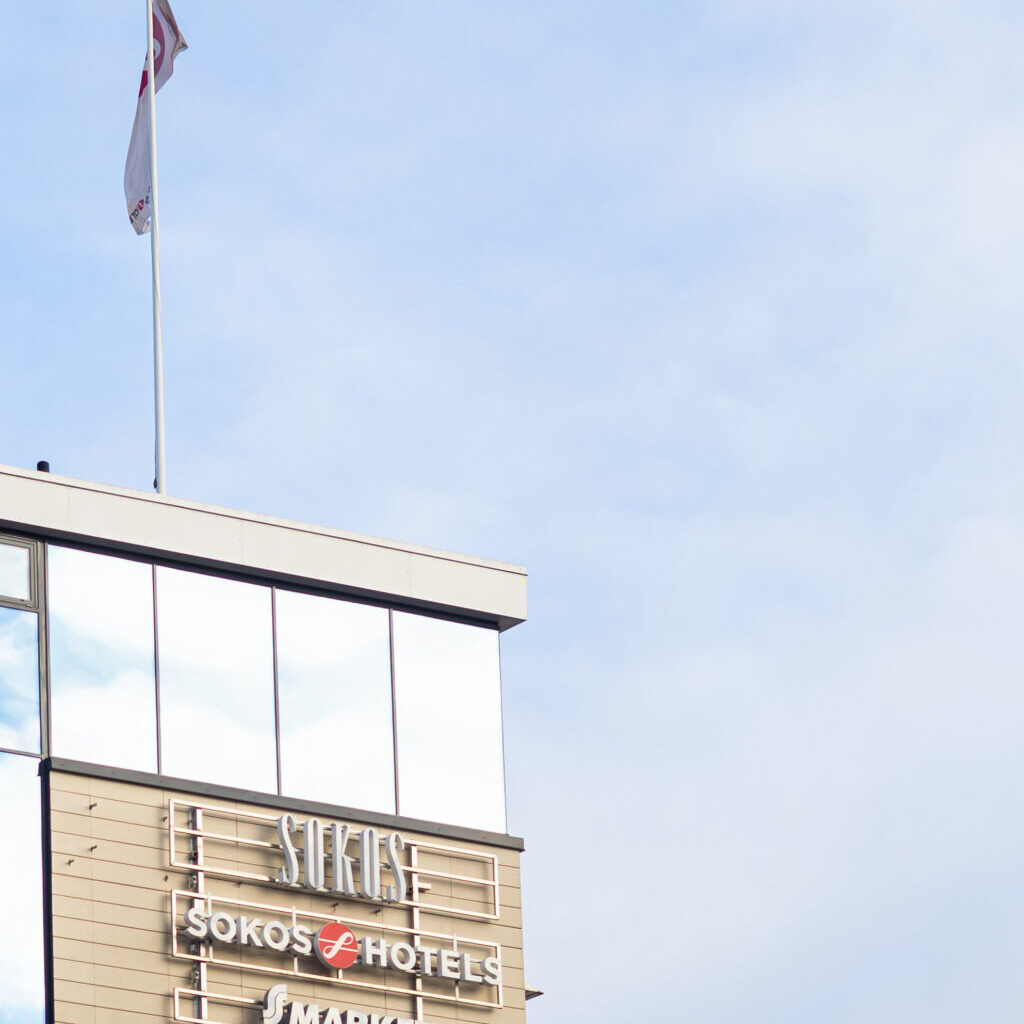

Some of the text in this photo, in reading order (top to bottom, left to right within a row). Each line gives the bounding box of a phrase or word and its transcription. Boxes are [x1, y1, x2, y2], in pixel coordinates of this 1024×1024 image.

[277, 813, 407, 902] SOKOS
[184, 907, 502, 986] SOKOS HOTELS
